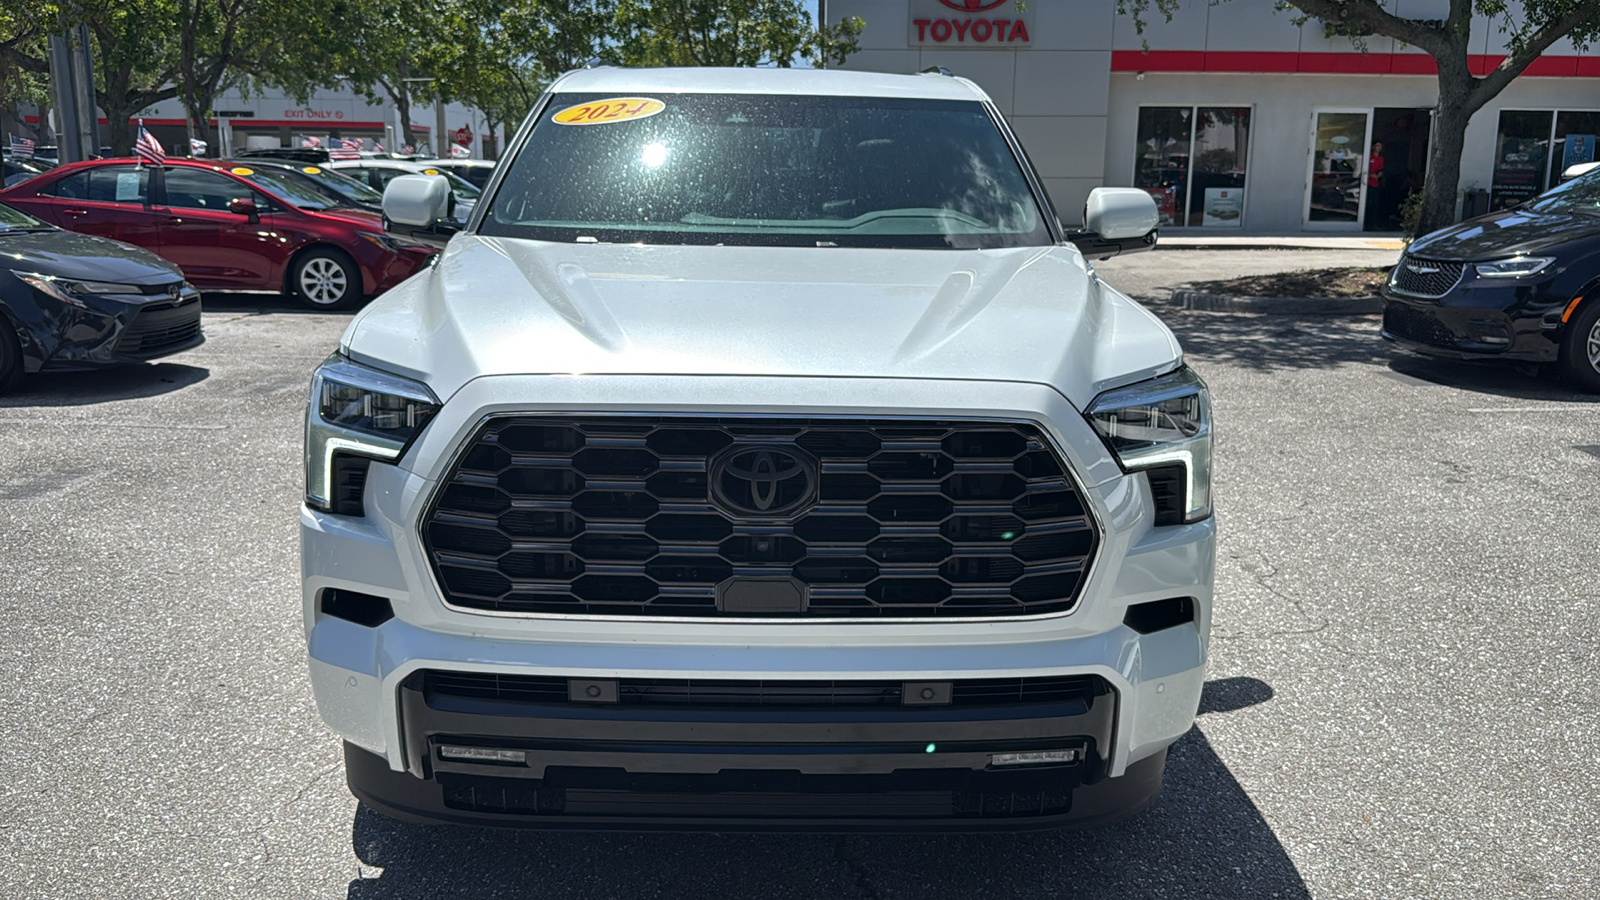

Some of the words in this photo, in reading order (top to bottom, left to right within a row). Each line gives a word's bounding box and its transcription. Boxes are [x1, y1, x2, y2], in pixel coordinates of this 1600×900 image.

[913, 18, 1030, 42] TOYOTA
[284, 110, 304, 118] EXIT
[307, 109, 332, 118] ONLY
[567, 101, 649, 122] 2024
